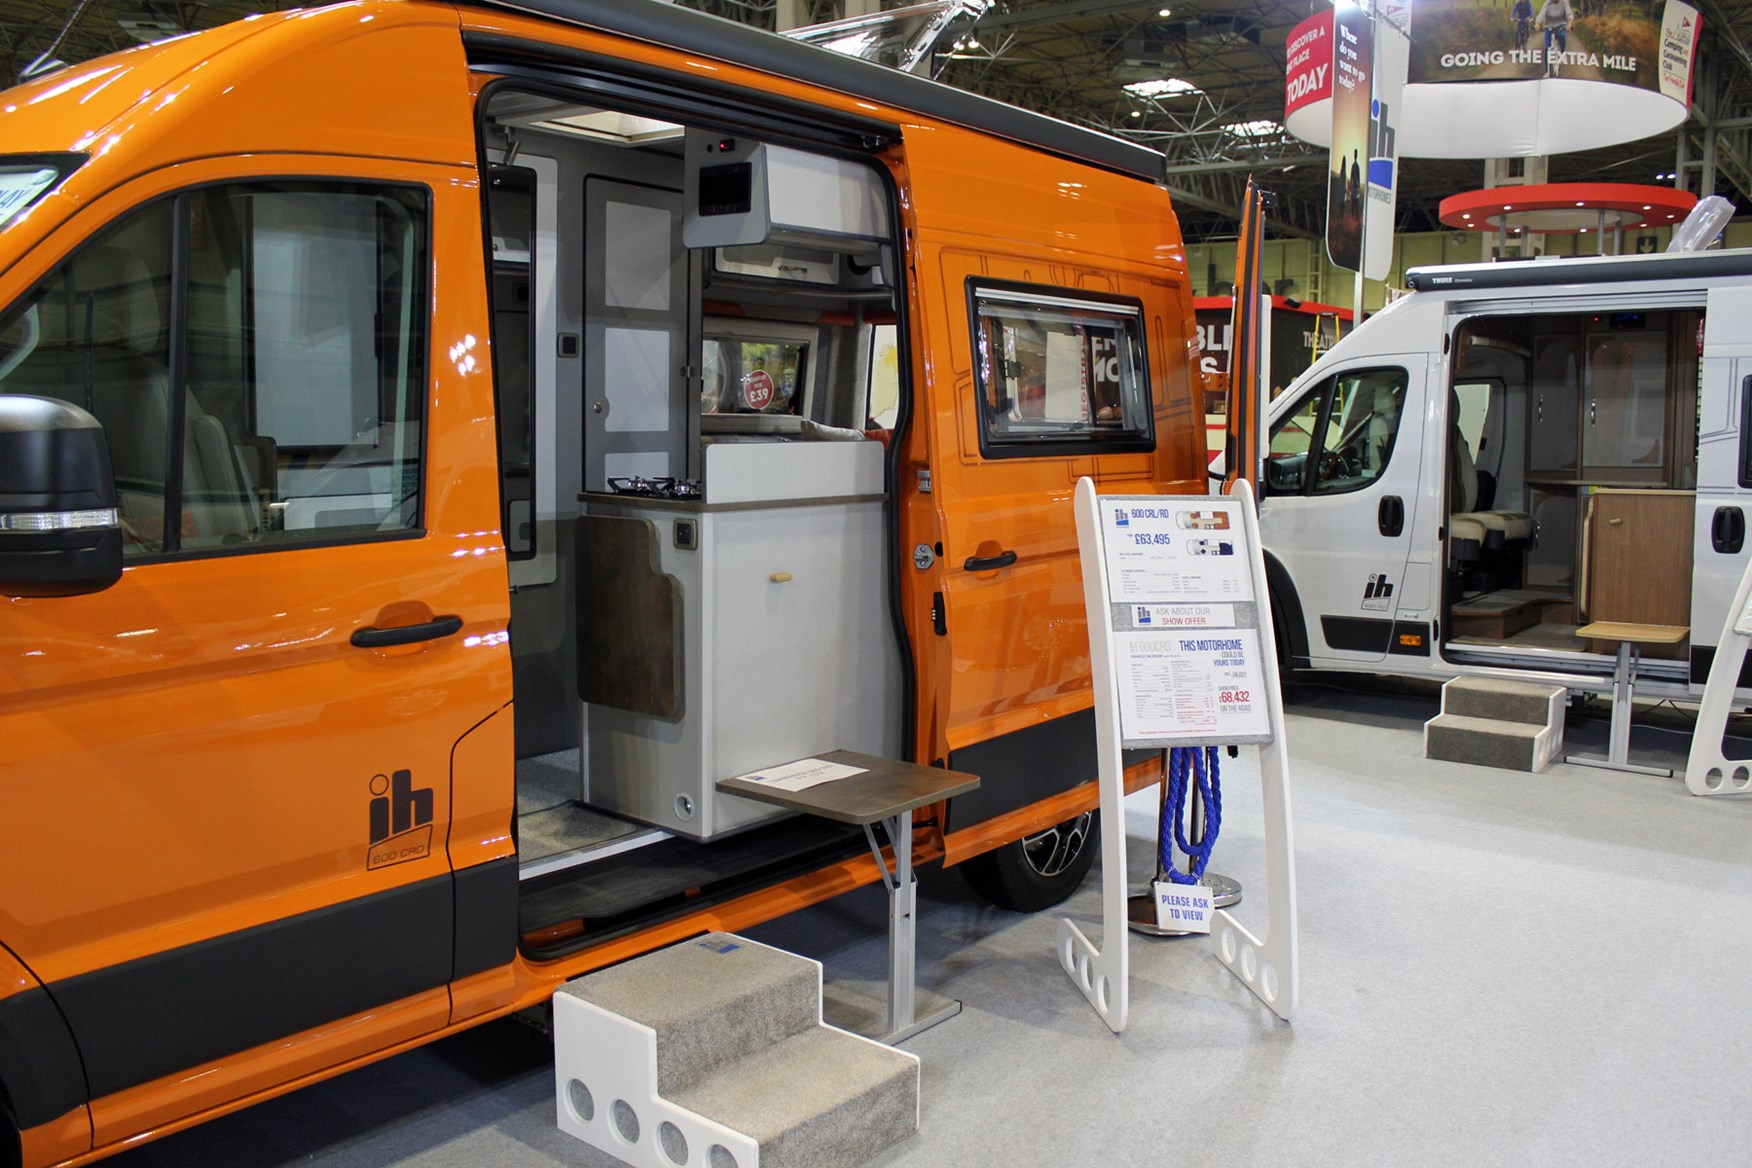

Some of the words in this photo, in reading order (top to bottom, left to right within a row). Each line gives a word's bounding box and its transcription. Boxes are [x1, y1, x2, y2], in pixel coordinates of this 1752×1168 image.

[1290, 28, 1318, 55] DISCOVER
[1319, 26, 1325, 37] A
[1340, 24, 1357, 45] Where
[1339, 41, 1347, 55] do
[1347, 48, 1357, 60] you
[1664, 38, 1683, 55] Camping
[1292, 48, 1310, 68] PLACE
[1441, 51, 1504, 67] GOING
[1508, 50, 1542, 63] THE
[1547, 51, 1599, 67] EXTRA
[1602, 54, 1636, 71] MILE
[1663, 49, 1687, 69] Caravanning
[1663, 60, 1672, 71] Club
[1339, 60, 1352, 73] want
[1352, 66, 1358, 77] to
[1358, 71, 1366, 83] go
[1287, 63, 1328, 106] TODAY
[1339, 75, 1356, 92] today?
[1369, 98, 1395, 159] ih
[1432, 276, 1453, 284] THULE
[750, 388, 769, 402] £39
[1134, 533, 1170, 545] £63,495
[1364, 573, 1394, 599] ih
[1155, 607, 1170, 615] ASK
[1171, 607, 1194, 615] ABOUT
[1195, 607, 1211, 615] OUR
[1162, 617, 1183, 625] SHOW
[1184, 617, 1206, 625] OFFER
[1179, 640, 1196, 651] THIS
[1197, 639, 1243, 651] MOTORHOME
[1228, 704, 1238, 712] THE
[369, 769, 434, 845] ih
[373, 851, 397, 865] 600
[400, 845, 425, 858] CRD
[1161, 894, 1191, 908] PLEASE
[1193, 897, 1209, 909] ASK
[1169, 908, 1180, 919] TO
[1181, 910, 1203, 921] VIEW
